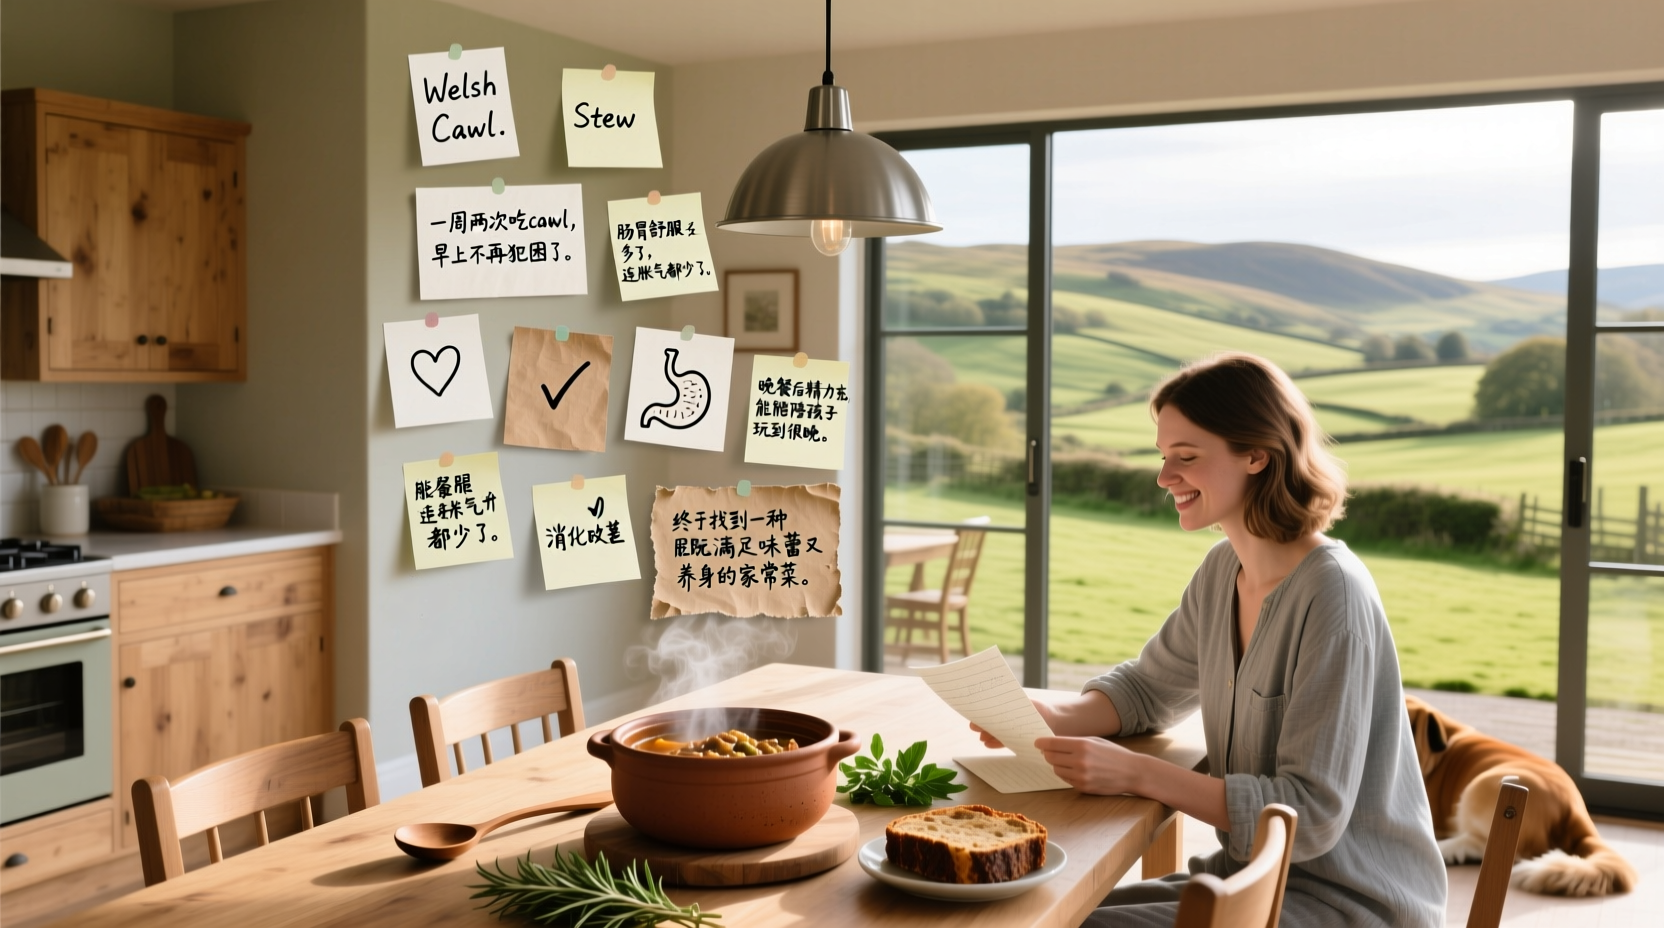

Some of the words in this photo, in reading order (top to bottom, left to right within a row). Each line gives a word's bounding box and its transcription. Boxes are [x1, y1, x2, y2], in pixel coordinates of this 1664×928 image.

[424, 70, 497, 104] Welsh
[432, 110, 505, 143] Cawl.
[574, 102, 636, 128] Stew
[431, 241, 572, 268] 早上不再犯困了。
[427, 523, 498, 551] 都少了。
[677, 560, 809, 592] 养身的家常菜。
